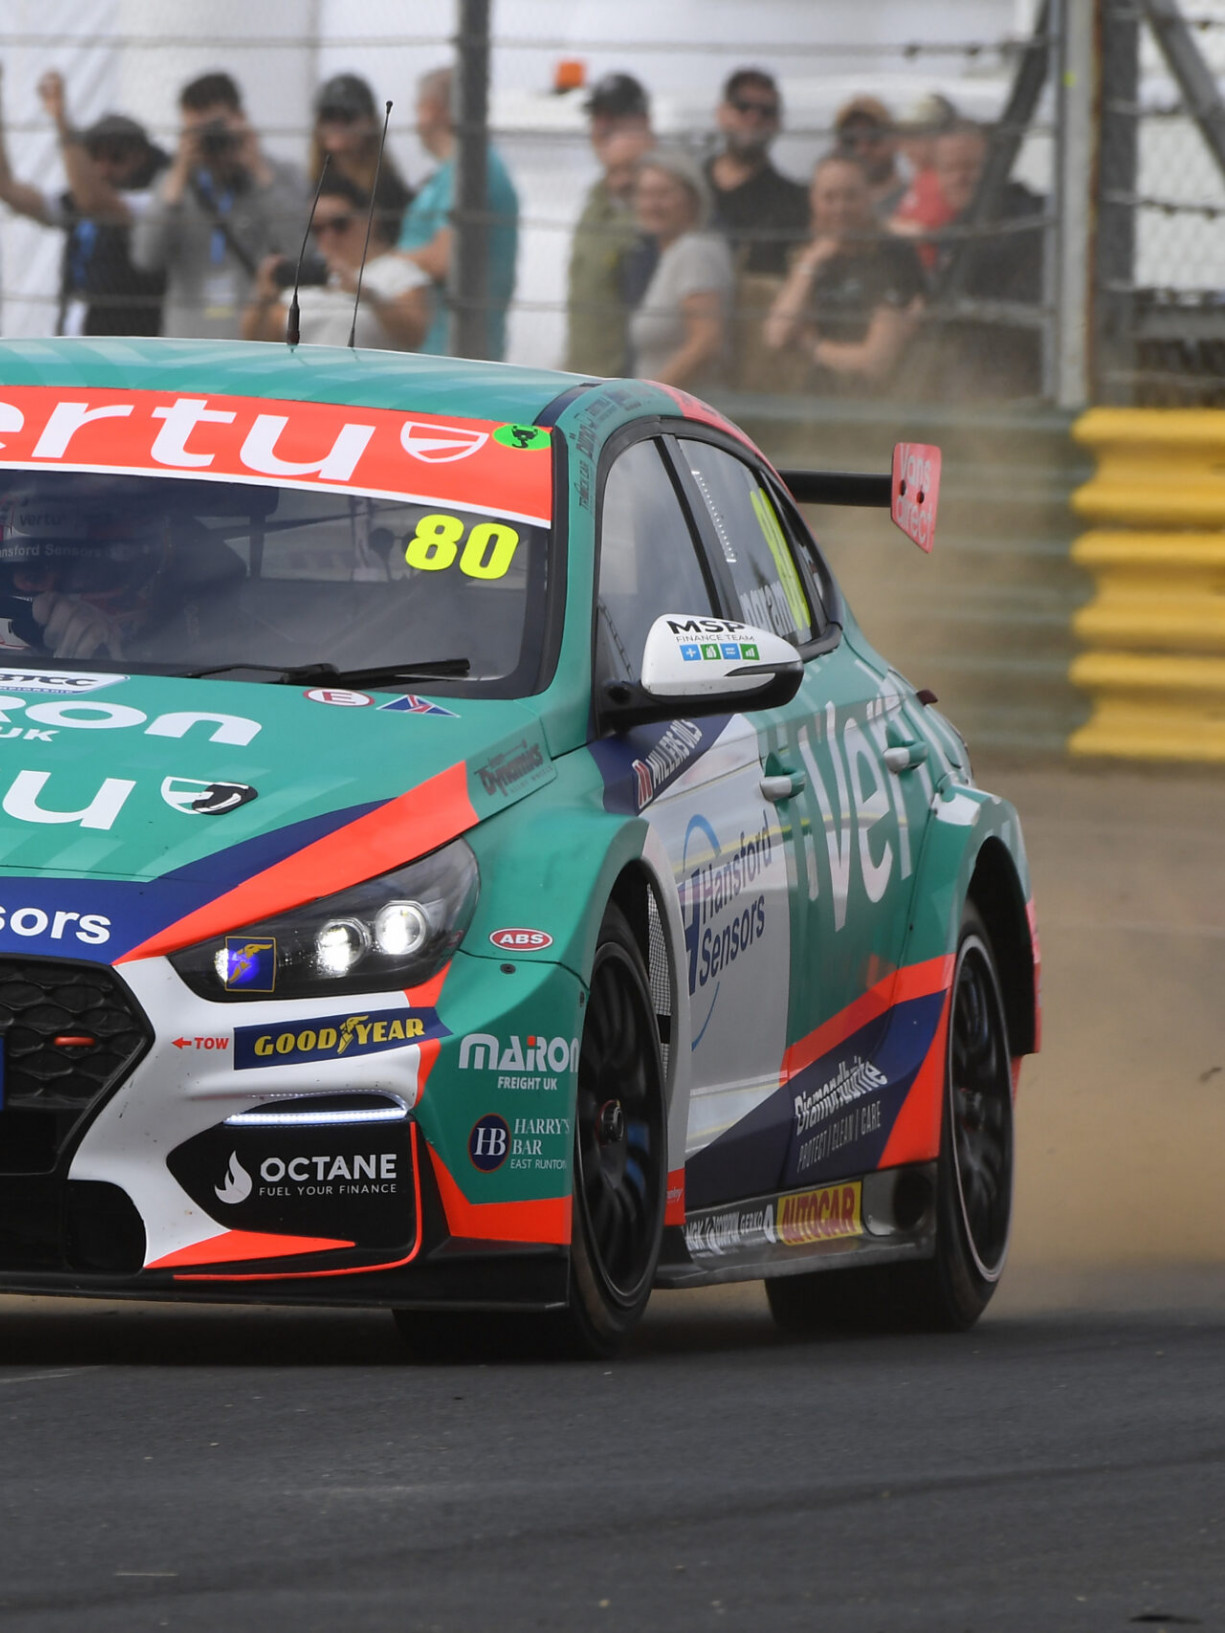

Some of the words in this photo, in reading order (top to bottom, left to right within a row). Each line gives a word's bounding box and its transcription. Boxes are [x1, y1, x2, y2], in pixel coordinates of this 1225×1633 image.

[404, 514, 520, 581] 80
[667, 620, 746, 635] MSP
[676, 634, 723, 643] FINANCE
[726, 634, 755, 642] TEAM
[645, 731, 690, 789] MILLERS
[703, 810, 772, 924] Hansford
[499, 933, 544, 946] ABS
[699, 894, 765, 987] Sensors
[194, 1037, 229, 1050] TOW
[497, 1076, 541, 1090] FREIGHT
[543, 1078, 557, 1090] UK
[861, 1101, 881, 1135] CARE
[474, 1127, 506, 1156] HB
[512, 1139, 542, 1155] BAR
[259, 1153, 397, 1182] OCTANE
[510, 1159, 532, 1169] EAST
[259, 1185, 293, 1197] FUEL
[297, 1184, 333, 1196] YOUR
[339, 1183, 397, 1195] FINANCE
[782, 1187, 857, 1244] AUTOCAR
